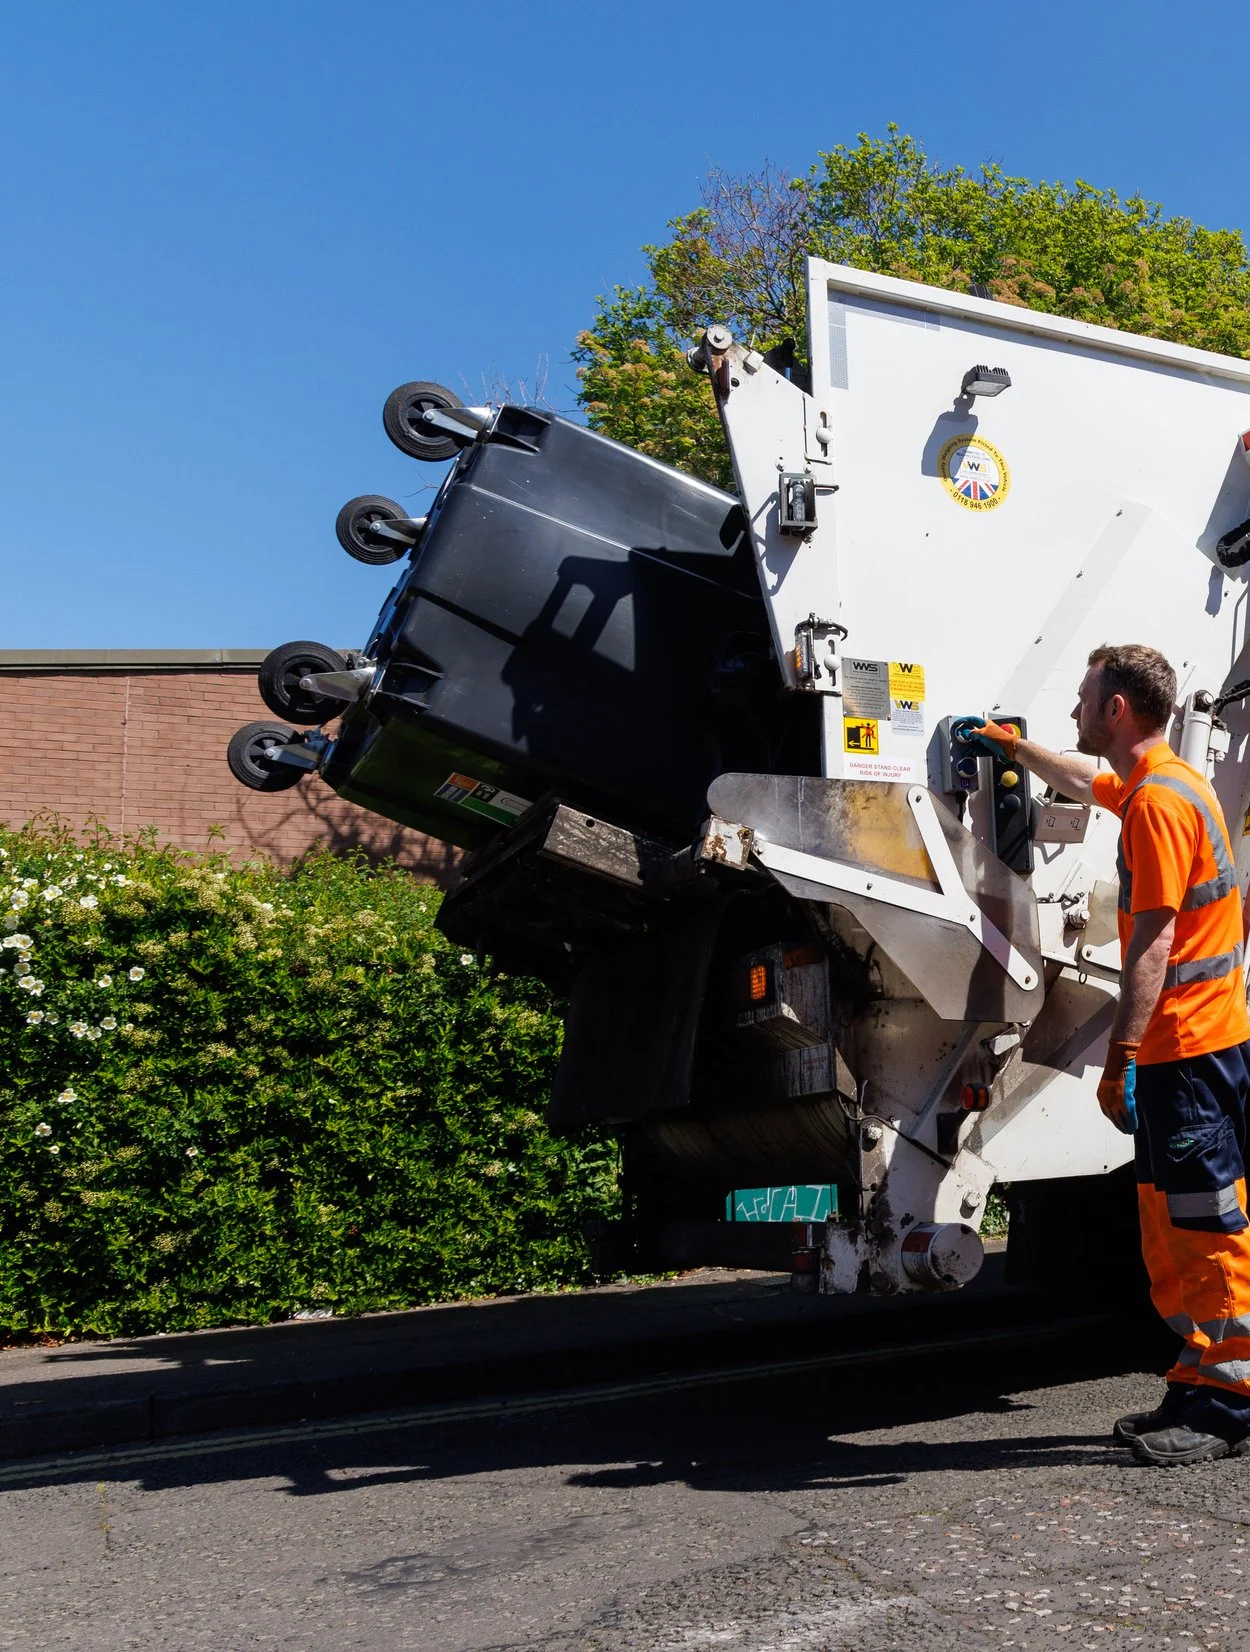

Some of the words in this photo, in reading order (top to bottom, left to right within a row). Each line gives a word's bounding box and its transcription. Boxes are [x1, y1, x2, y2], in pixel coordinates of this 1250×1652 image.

[952, 491, 969, 506] 0118
[969, 501, 983, 510] 946
[983, 497, 999, 510] 1900
